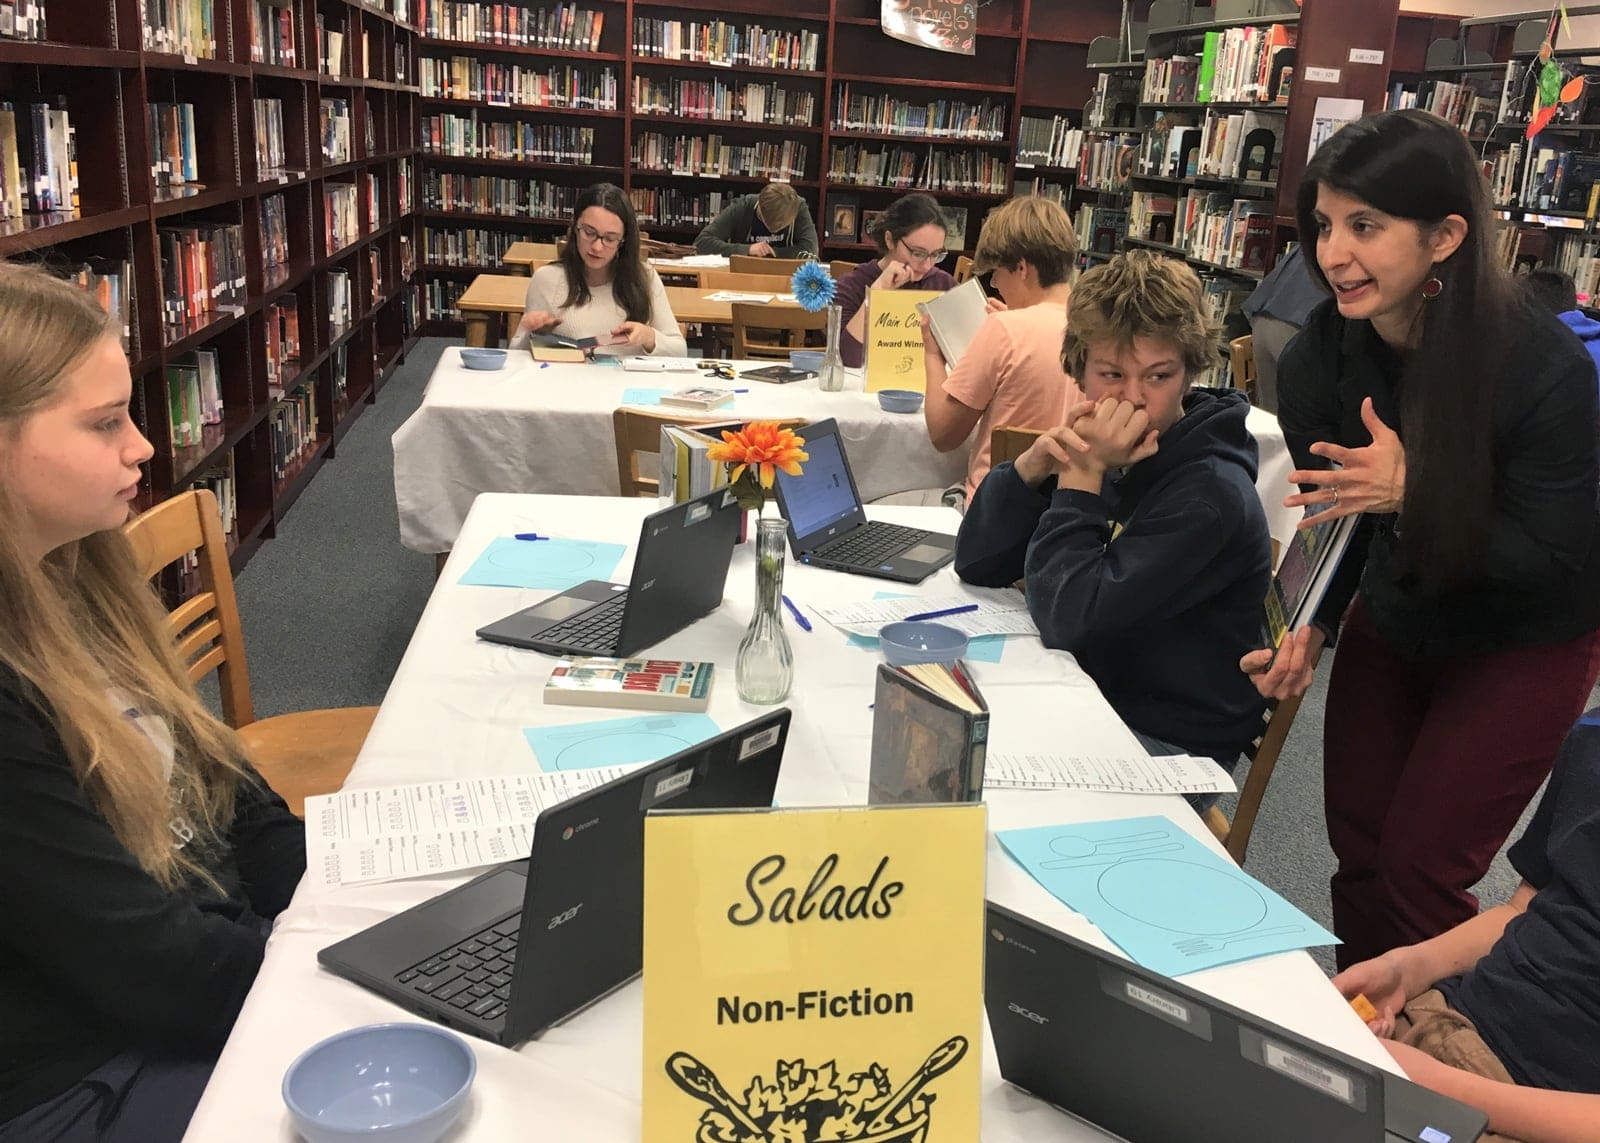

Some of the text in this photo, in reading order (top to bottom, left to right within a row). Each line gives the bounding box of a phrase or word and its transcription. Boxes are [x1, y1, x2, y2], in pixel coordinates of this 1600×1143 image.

[874, 312, 900, 328] Main
[877, 340, 902, 348] Award
[575, 817, 600, 833] chrome
[727, 853, 904, 926] Salads
[547, 903, 583, 930] acer
[717, 987, 913, 1025] Non-Fiction
[1008, 1002, 1049, 1024] acer
